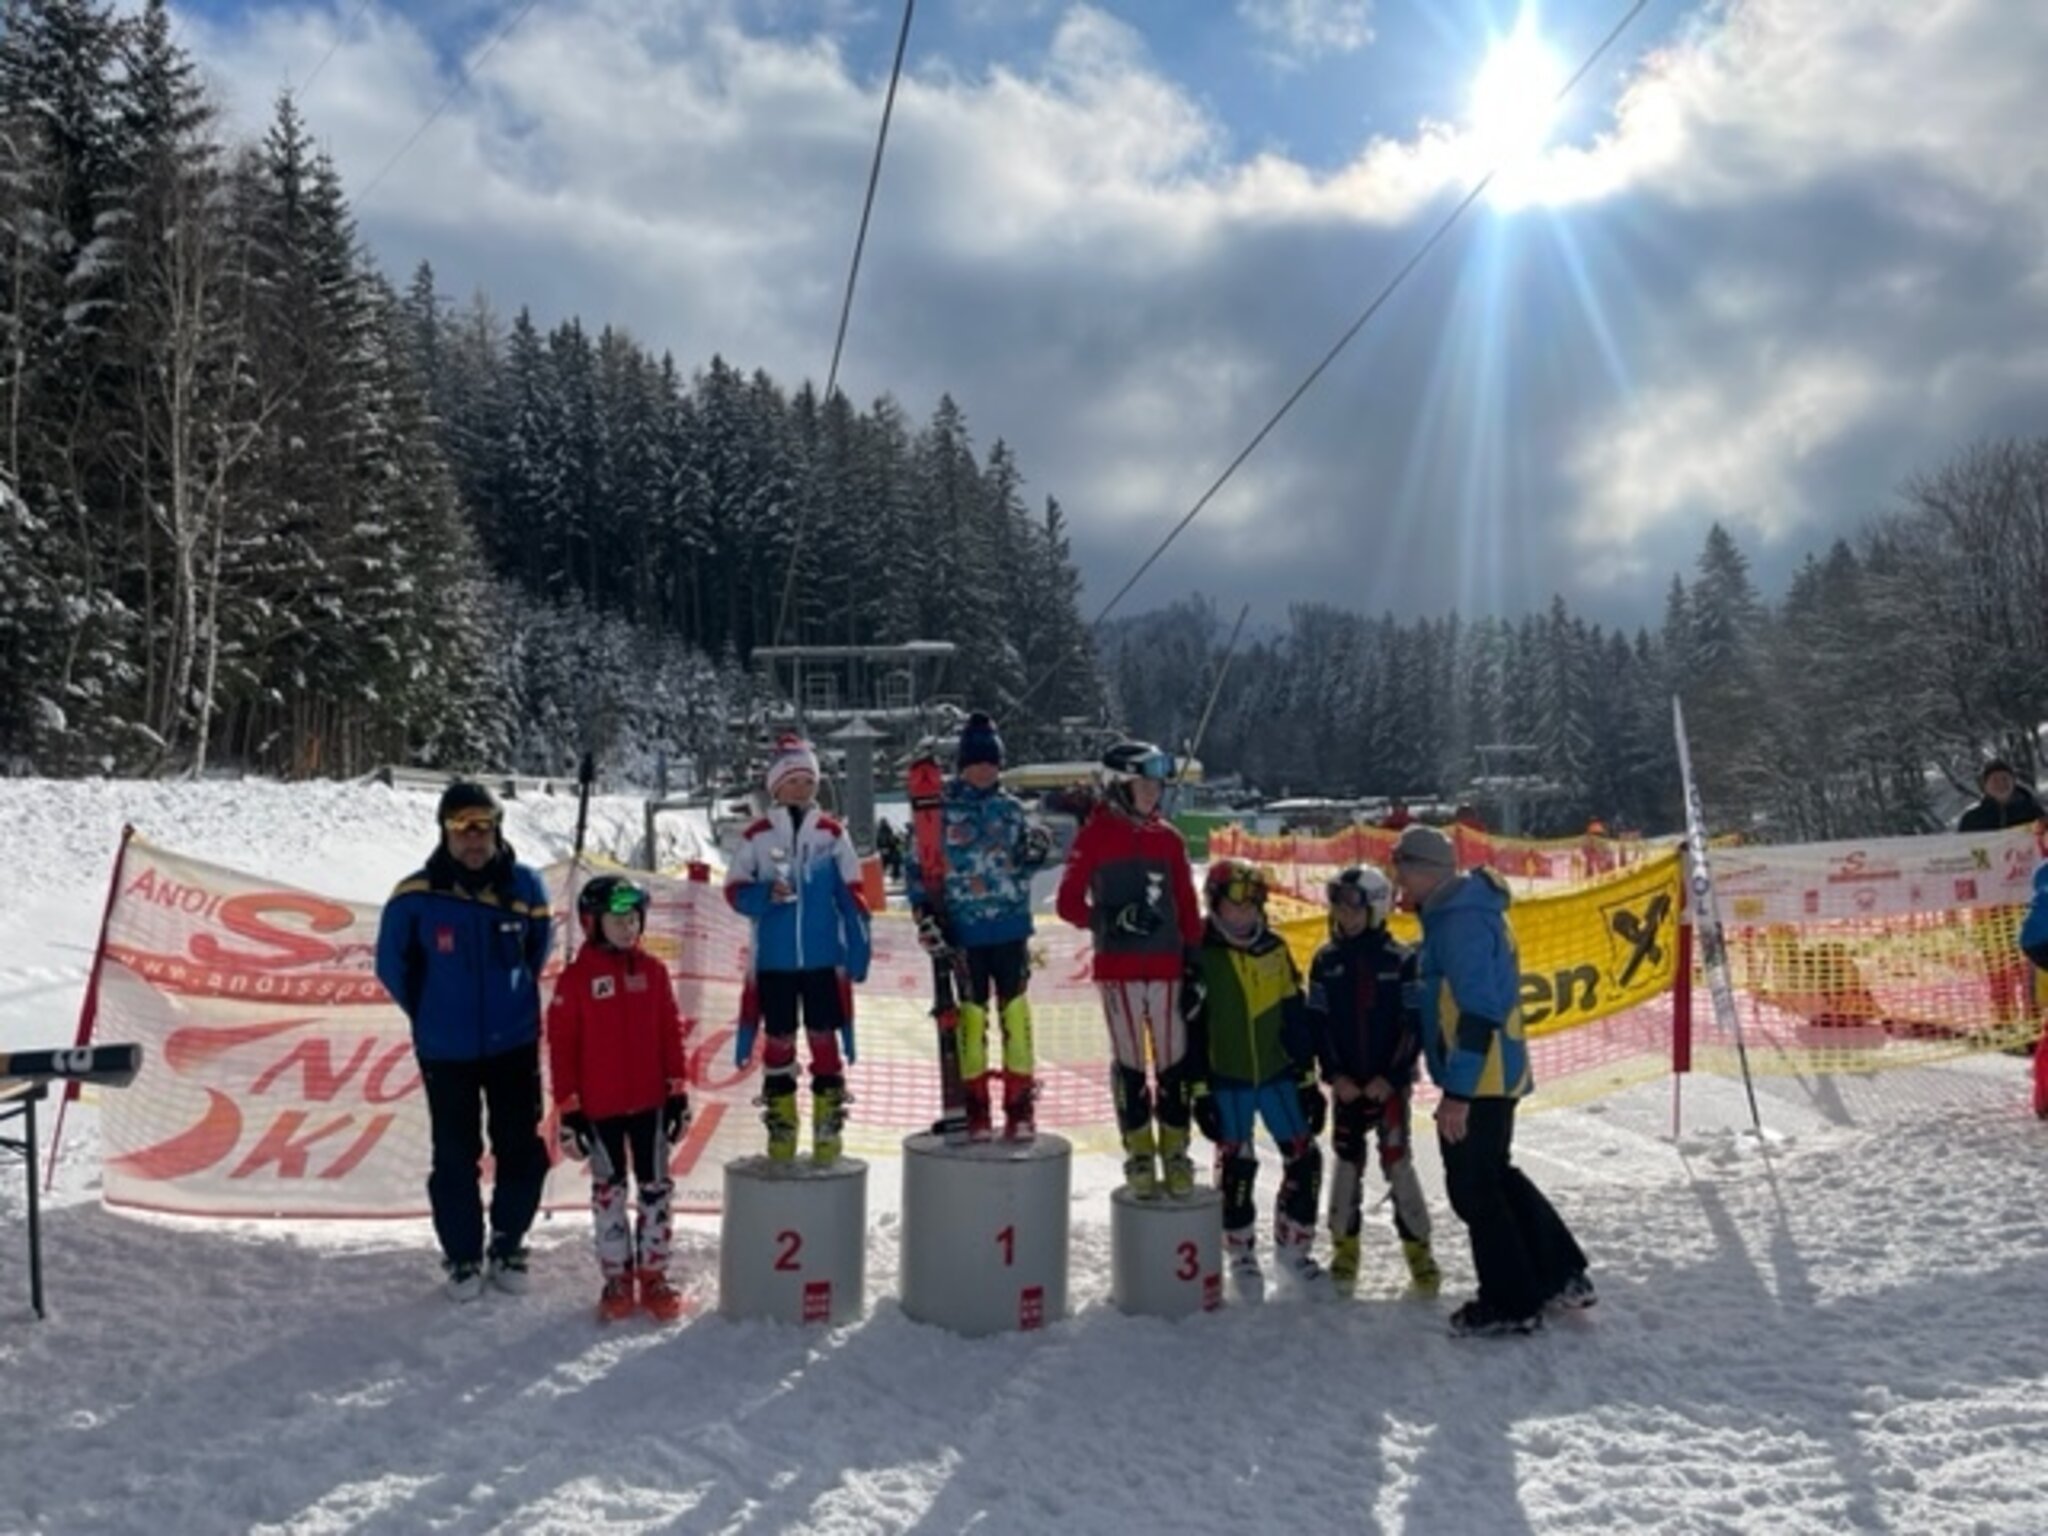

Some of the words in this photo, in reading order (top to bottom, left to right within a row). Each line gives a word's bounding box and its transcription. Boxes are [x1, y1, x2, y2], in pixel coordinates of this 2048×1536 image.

[773, 1230, 802, 1272] 2
[995, 1224, 1015, 1267] 1
[1176, 1240, 1199, 1281] 3
